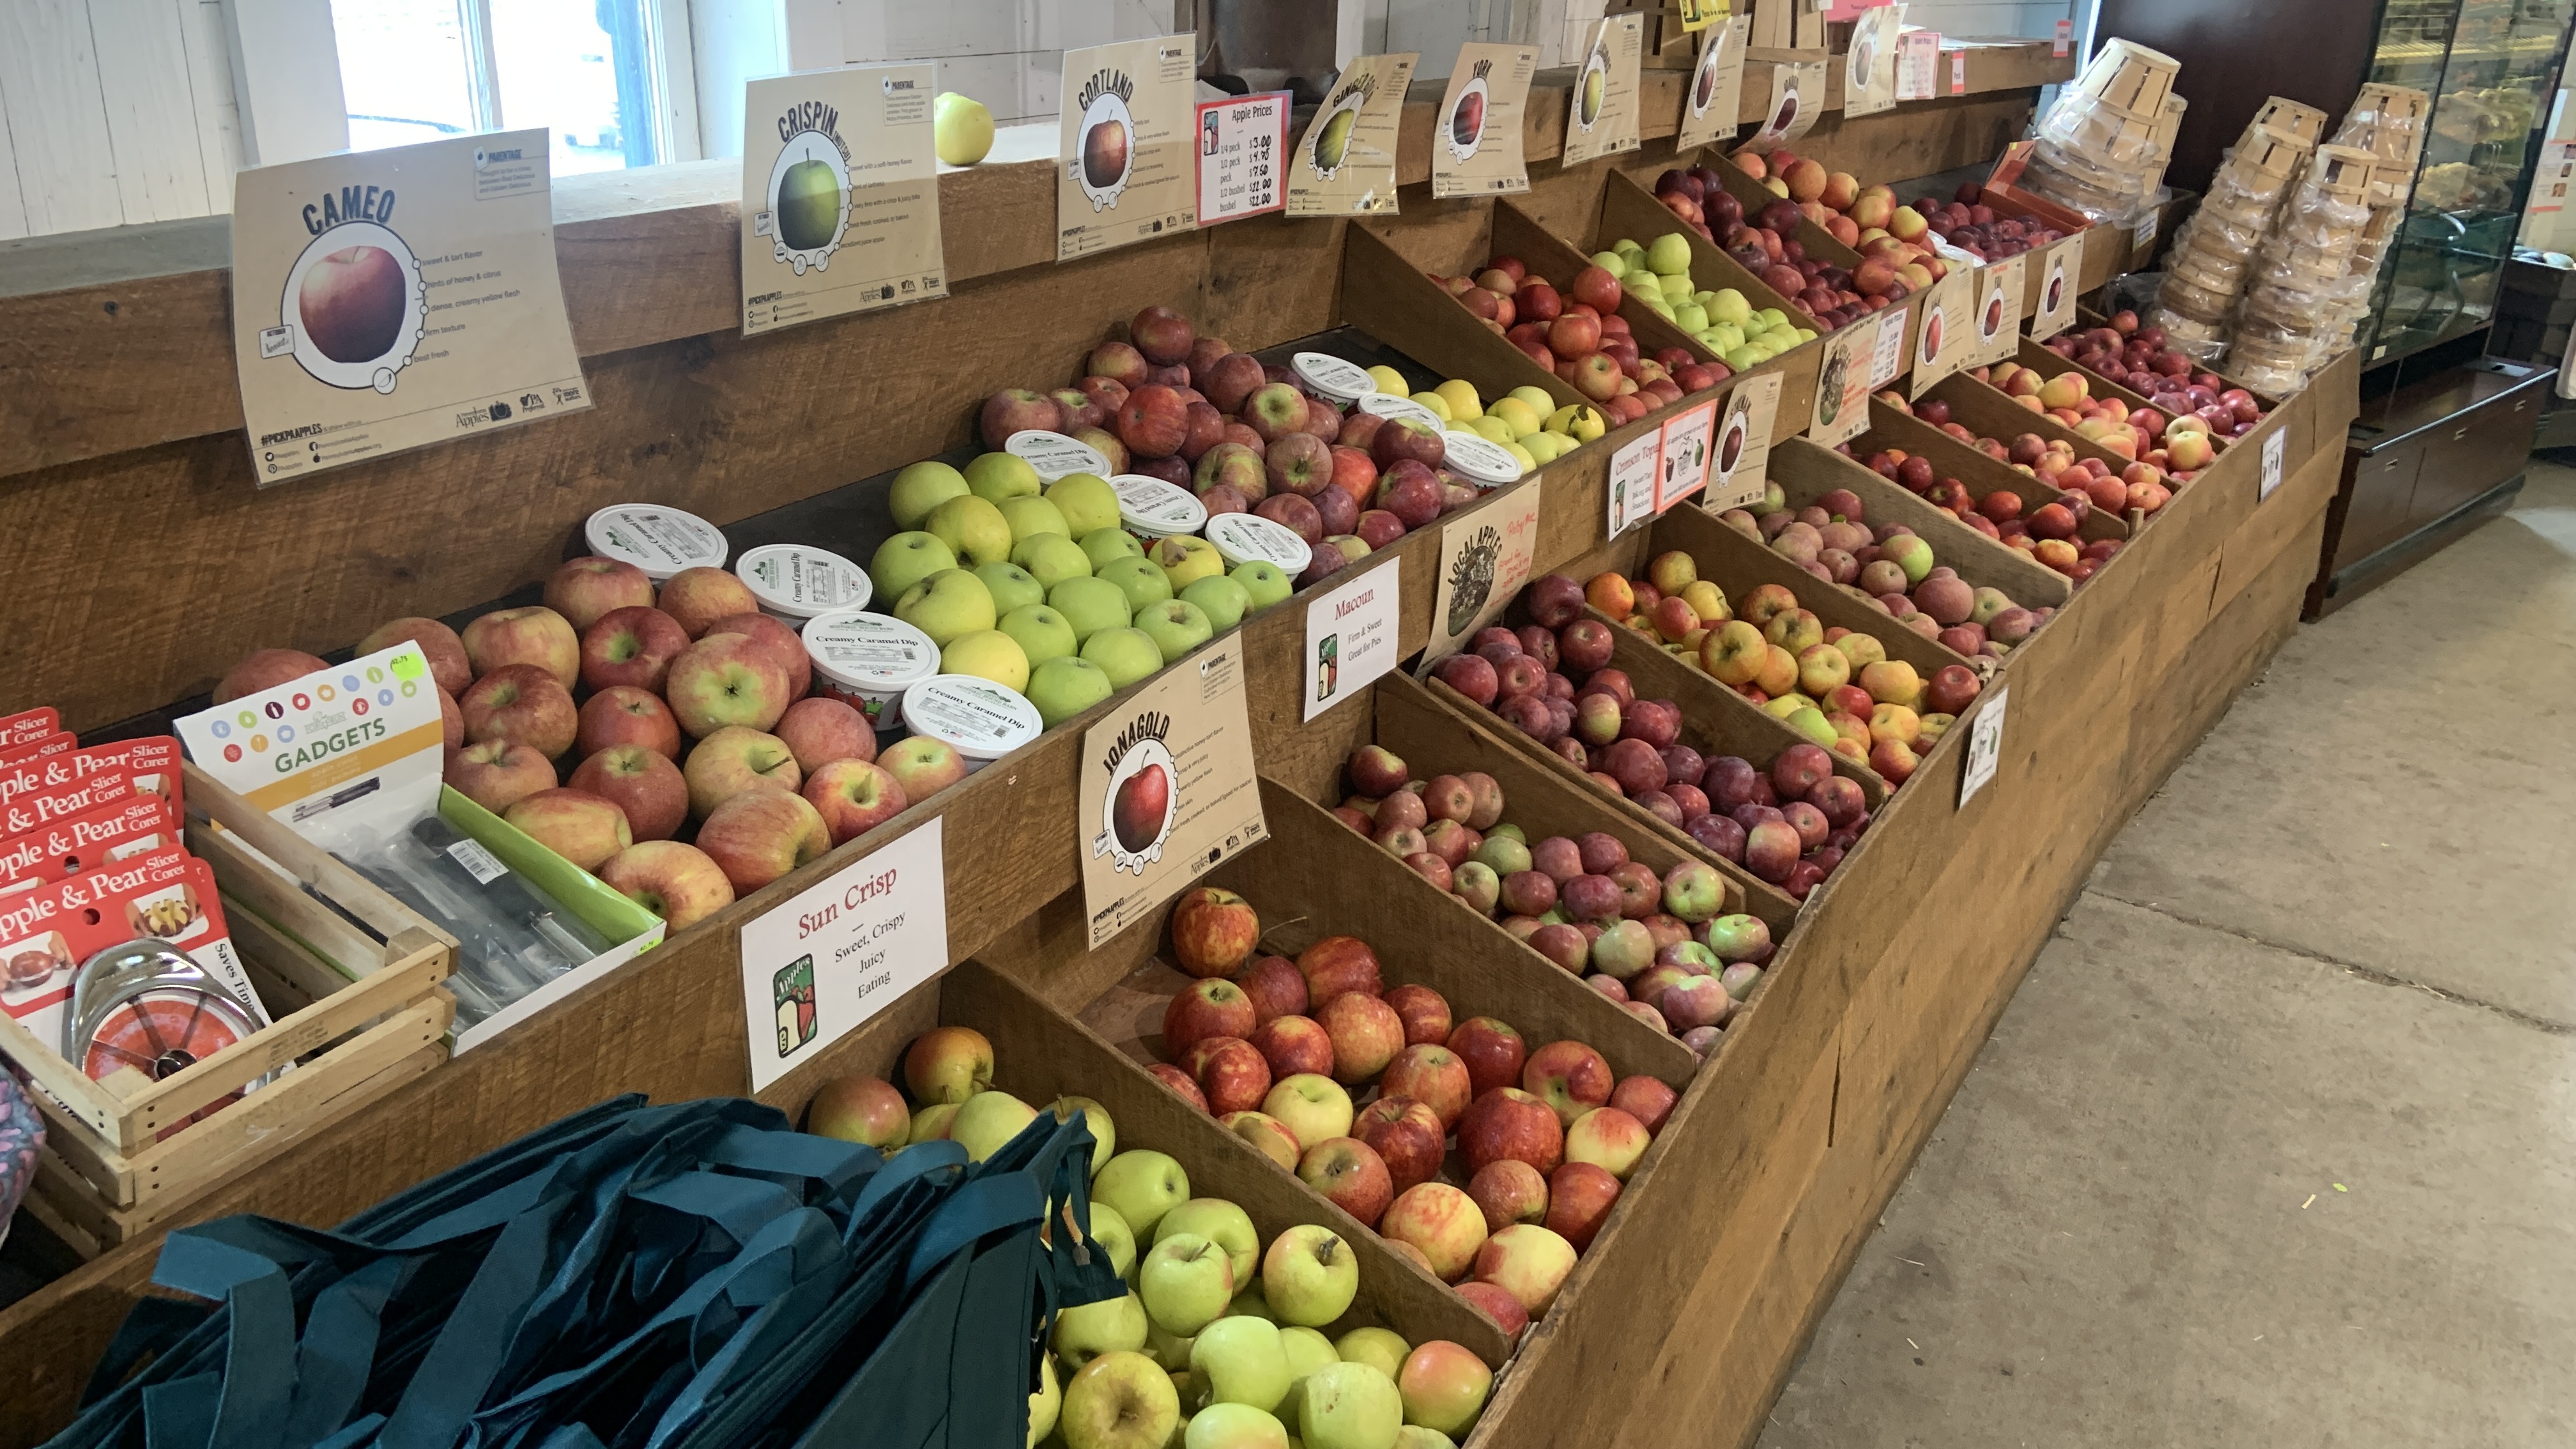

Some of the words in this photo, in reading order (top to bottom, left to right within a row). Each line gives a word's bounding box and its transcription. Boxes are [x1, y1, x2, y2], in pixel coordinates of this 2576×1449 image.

[1078, 68, 1133, 111] CORTLAND
[778, 101, 838, 142] CRISPIN
[1232, 107, 1251, 123] Apple
[1253, 105, 1272, 118] Prices
[1229, 142, 1241, 154] peck
[1249, 135, 1271, 149] $3.00
[489, 149, 522, 162] PARENTAGE
[1229, 157, 1241, 169] peck
[1249, 148, 1270, 163] $4.75
[1220, 172, 1232, 185] peck
[1249, 164, 1268, 178] $7.50
[1229, 184, 1245, 195] bushel
[302, 185, 396, 236] CAMEO
[1220, 200, 1236, 212] bushel
[422, 256, 443, 266] sweet
[454, 275, 475, 284] honey
[483, 271, 502, 279] citrus
[456, 298, 480, 308] creamy
[481, 294, 503, 303] yellow
[504, 289, 521, 298] flesh
[441, 324, 466, 333] texture
[414, 353, 429, 363] best
[431, 350, 449, 358] fresh
[564, 388, 579, 397] more
[456, 407, 489, 428] Apples
[261, 423, 323, 447] #PICKPAAPPLES
[1616, 452, 1641, 476] Crimson
[620, 513, 632, 525] Dip
[629, 522, 659, 544] Caramel
[659, 544, 682, 565] Creamy
[793, 553, 802, 562] Dip
[1448, 535, 1475, 585] LOCAL
[1477, 525, 1503, 560] APPLES
[790, 561, 802, 582] Caramel
[792, 584, 804, 602] Creamy
[1335, 586, 1374, 621] Macoun
[857, 637, 899, 645] Caramel
[1347, 630, 1360, 645] Firm
[1361, 628, 1367, 637] &
[1367, 618, 1383, 634] Sweet
[1347, 646, 1362, 661] Great
[1370, 636, 1382, 650] Pies
[928, 687, 967, 705] Creamy
[967, 702, 1008, 721] Caramel
[1008, 718, 1025, 730] Dip
[13, 716, 49, 733] Slicer
[13, 727, 49, 744] Corer
[275, 717, 386, 773] GADGETS
[1103, 711, 1170, 776] JONAGOLD
[40, 741, 70, 758] Slicer
[132, 744, 170, 758] Slicer
[132, 756, 171, 769] Corer
[1192, 759, 1200, 768] very
[1199, 753, 1209, 763] juicy
[0, 769, 39, 804] ple
[45, 762, 72, 786] &
[72, 752, 130, 778] Pear
[91, 772, 122, 792] Slicer
[95, 786, 126, 803] Corer
[8, 807, 34, 832] &
[33, 786, 92, 823] Pear
[125, 802, 157, 820] Slicer
[129, 815, 161, 831] Corer
[48, 832, 72, 857] &
[71, 815, 127, 848] Pear
[146, 853, 181, 871] Slicer
[151, 864, 186, 883] Corer
[61, 884, 90, 910] &
[88, 866, 148, 901] Pear
[799, 903, 839, 940] Sun
[845, 868, 897, 910] Crisp
[835, 935, 870, 963] Sweet,
[873, 911, 906, 939] Crispy
[215, 943, 238, 979] Saves
[859, 949, 885, 973] Juicy
[777, 957, 811, 1001] Apples
[858, 970, 891, 1000] Eating
